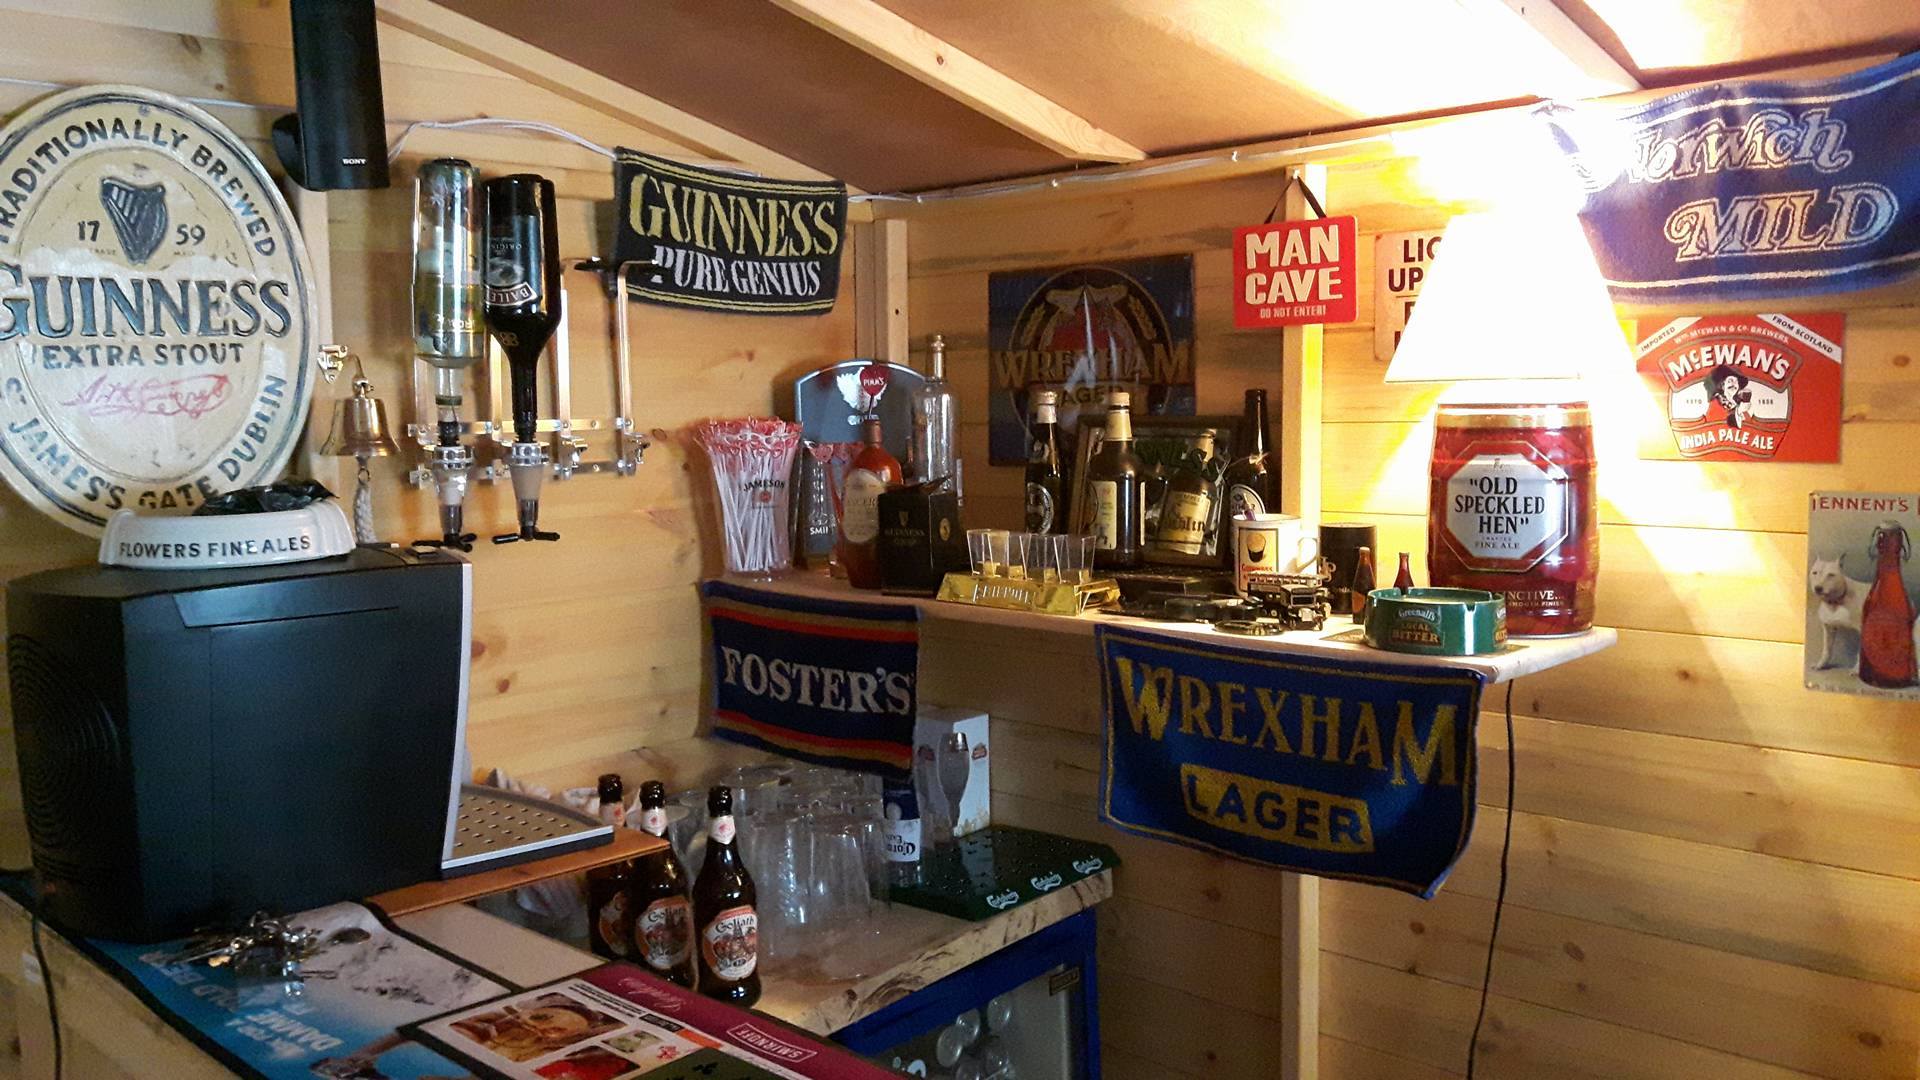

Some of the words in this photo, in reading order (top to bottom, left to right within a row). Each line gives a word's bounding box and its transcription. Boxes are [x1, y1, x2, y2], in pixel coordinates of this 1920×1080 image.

[191, 144, 275, 256] BREWED
[629, 172, 838, 257] GUINNESS
[78, 220, 100, 242] 17
[176, 223, 206, 246] 59
[1664, 182, 1900, 262] MILD
[1245, 224, 1340, 269] MAN
[651, 245, 730, 293] PURE
[730, 259, 821, 297] GENIUS
[1245, 266, 1343, 305] CAVE
[1388, 267, 1424, 292] UP
[0, 260, 292, 341] GUINNESS
[1260, 308, 1271, 319] DO
[1273, 307, 1291, 318] NOT
[1293, 304, 1327, 317] ENTER!
[1772, 315, 1795, 331] FROM
[1795, 328, 1833, 354] SCOTLAND
[43, 344, 144, 369] EXTRA
[154, 342, 244, 366] STOUT
[1667, 343, 1790, 381] McEWAN'S
[138, 475, 219, 510] GATE
[218, 375, 287, 482] DUBLIN
[1681, 431, 1715, 449] INDIA
[1718, 429, 1749, 444] PALE
[1751, 436, 1774, 450] ALE
[1454, 495, 1545, 515] SPECKLED
[120, 541, 200, 560] FLOWERS
[207, 539, 257, 558] FINE
[262, 535, 311, 552] ALES
[721, 646, 911, 716] FOSTER'S
[1115, 656, 1457, 785] WREXHAM
[1187, 774, 1366, 845] LAGER
[715, 916, 754, 933] Goliath
[736, 1029, 803, 1058] SMIRNOFF
